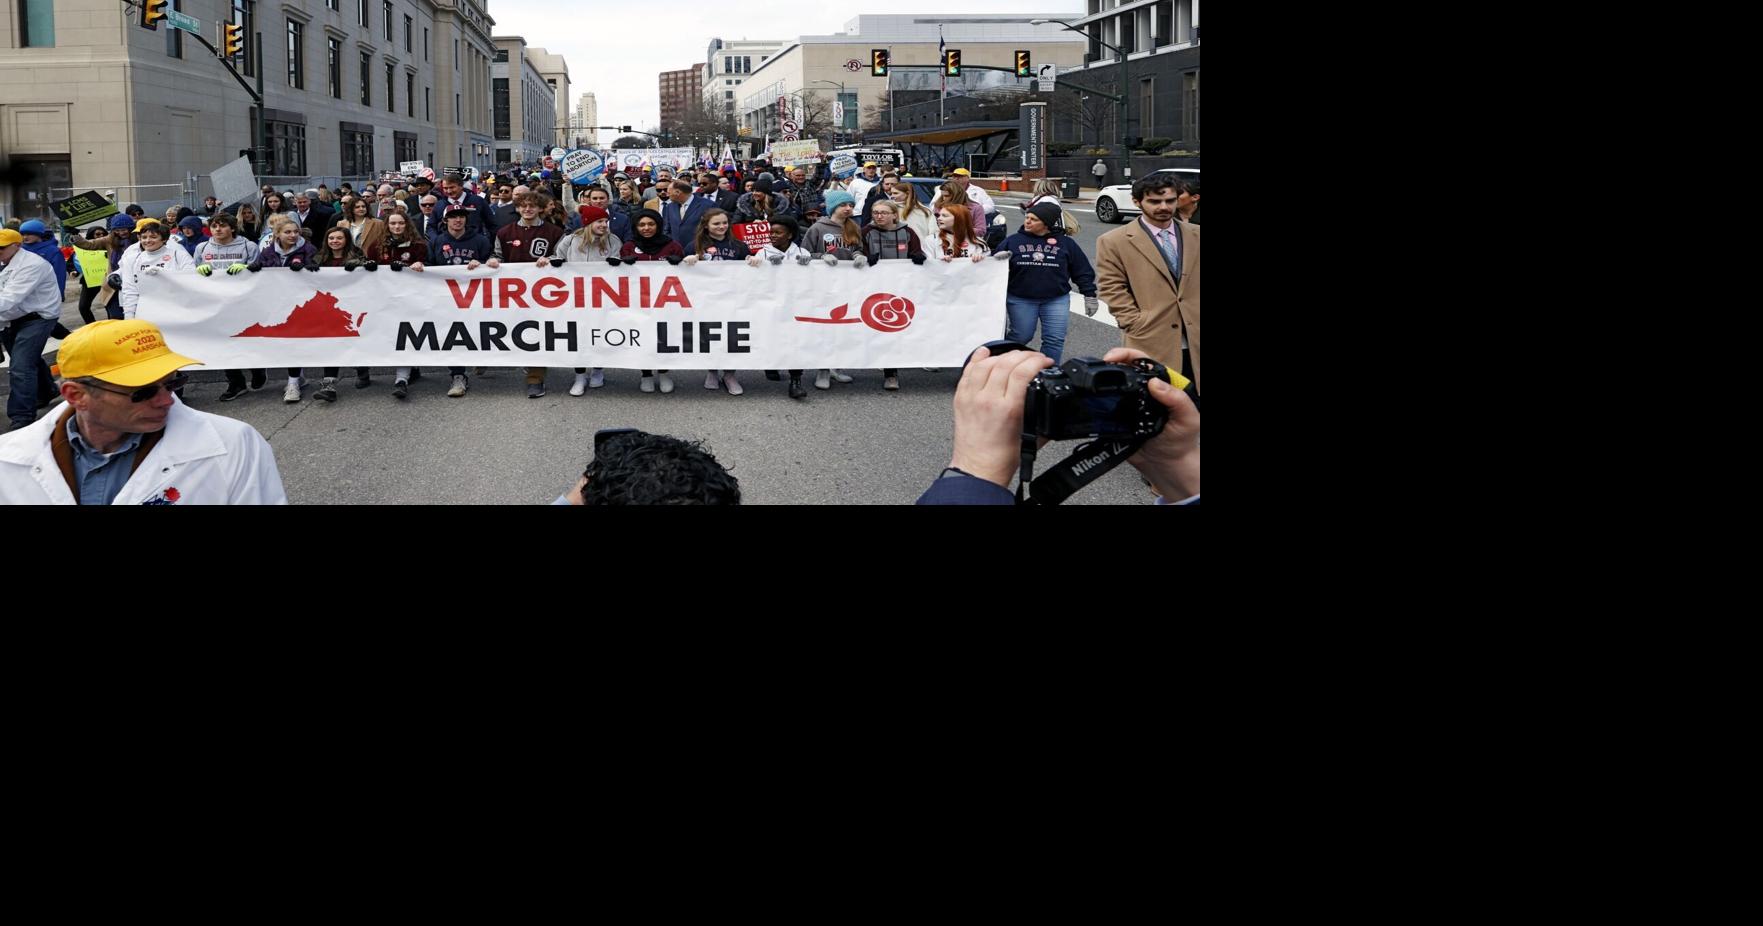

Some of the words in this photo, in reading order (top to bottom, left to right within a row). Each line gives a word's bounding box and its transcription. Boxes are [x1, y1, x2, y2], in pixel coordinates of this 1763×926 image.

[566, 151, 582, 161] PRAY
[566, 155, 598, 174] ABORTION
[575, 153, 590, 162] END
[72, 200, 95, 211] LIFE
[530, 237, 549, 259] G
[445, 276, 692, 309] VIRGINIA
[114, 331, 139, 346] MARCH
[135, 335, 156, 346] 2023
[395, 321, 578, 352] MARCH
[591, 328, 641, 347] FOR
[656, 321, 751, 354] LIFE
[1071, 450, 1110, 477] Nikon
